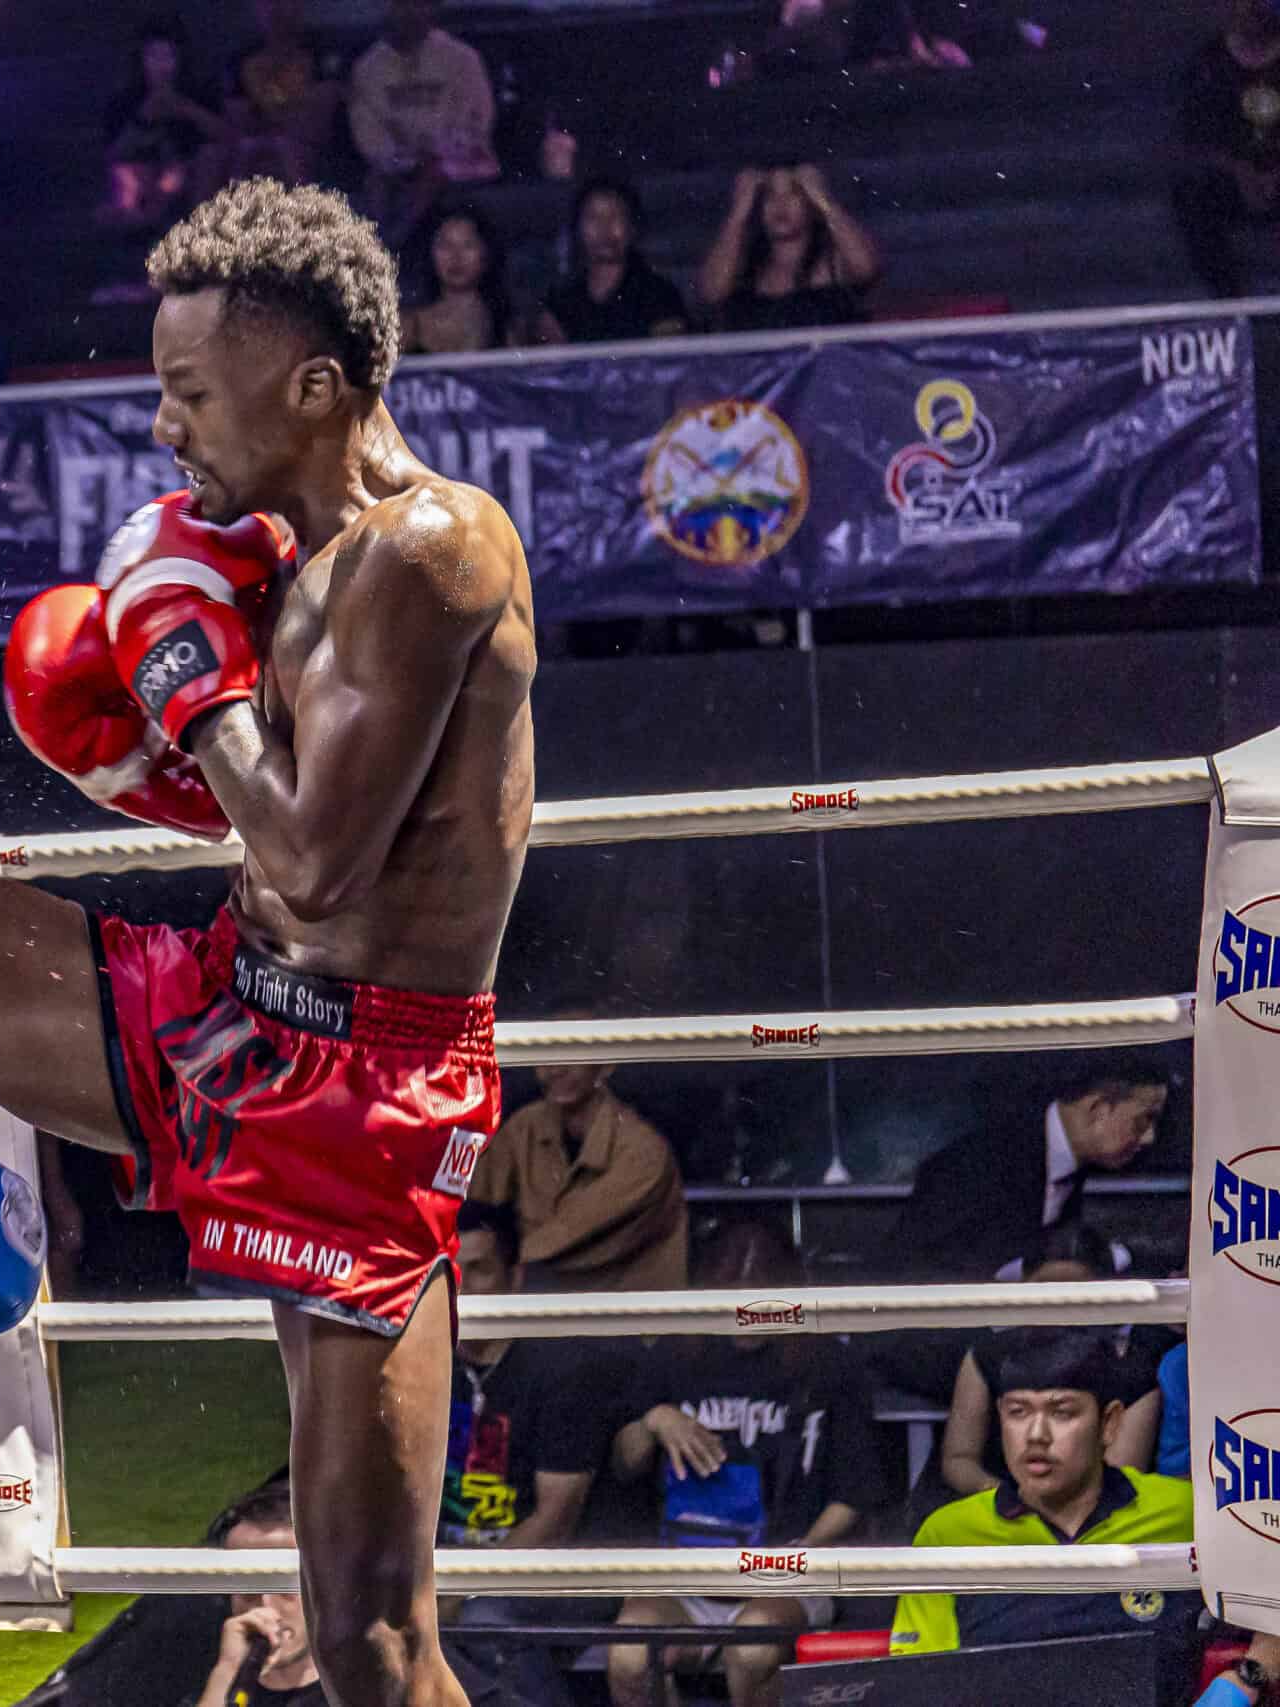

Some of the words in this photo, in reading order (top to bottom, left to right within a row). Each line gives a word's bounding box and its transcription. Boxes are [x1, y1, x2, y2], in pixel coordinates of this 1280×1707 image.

[1141, 328, 1236, 385] NOW
[791, 788, 858, 814] SANDEE
[296, 985, 344, 1033] Story
[751, 1023, 819, 1048] SANDEE
[203, 1217, 226, 1251] IN
[233, 1223, 353, 1281] THAILAND
[736, 1304, 805, 1326] SANDEE
[740, 1552, 806, 1576] SANDEE
